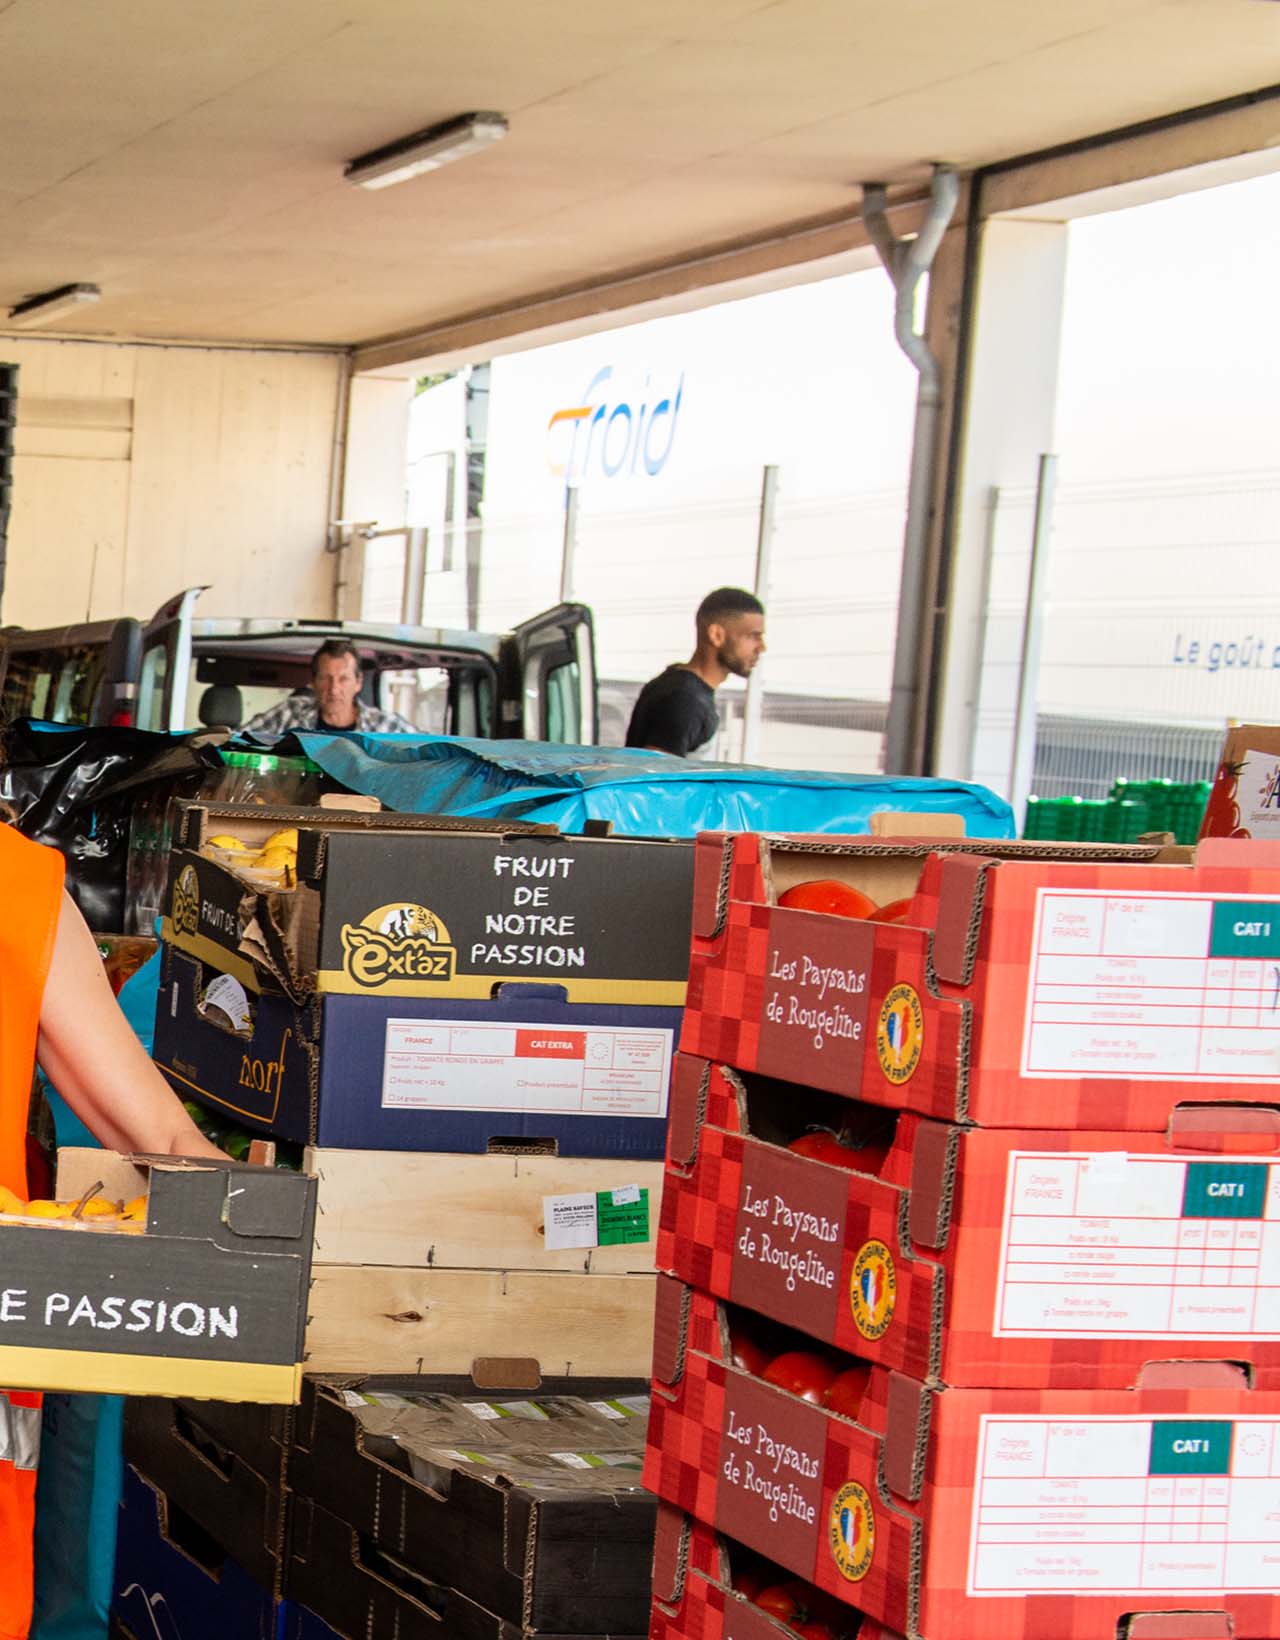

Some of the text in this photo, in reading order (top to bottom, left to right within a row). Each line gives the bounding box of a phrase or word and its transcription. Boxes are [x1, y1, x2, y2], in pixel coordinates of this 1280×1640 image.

[1174, 634, 1200, 663] Le
[494, 855, 574, 879] FRUIT
[513, 886, 549, 907] DE
[485, 914, 575, 936] NOTRE
[1233, 922, 1260, 936] CAT
[471, 943, 585, 967] PASSION
[770, 951, 866, 999] Les Paysans
[766, 992, 862, 1049] de Rougeline
[530, 1040, 573, 1049] CAT EXTRA
[1207, 1183, 1235, 1197] CAT
[742, 1185, 839, 1242] Les Paysans
[739, 1227, 835, 1291] de Rougeline
[44, 1292, 239, 1339] PASSION
[726, 1411, 819, 1479] Les Paysans
[1173, 1440, 1200, 1453] CAT
[723, 1452, 816, 1525] de Rougeline
